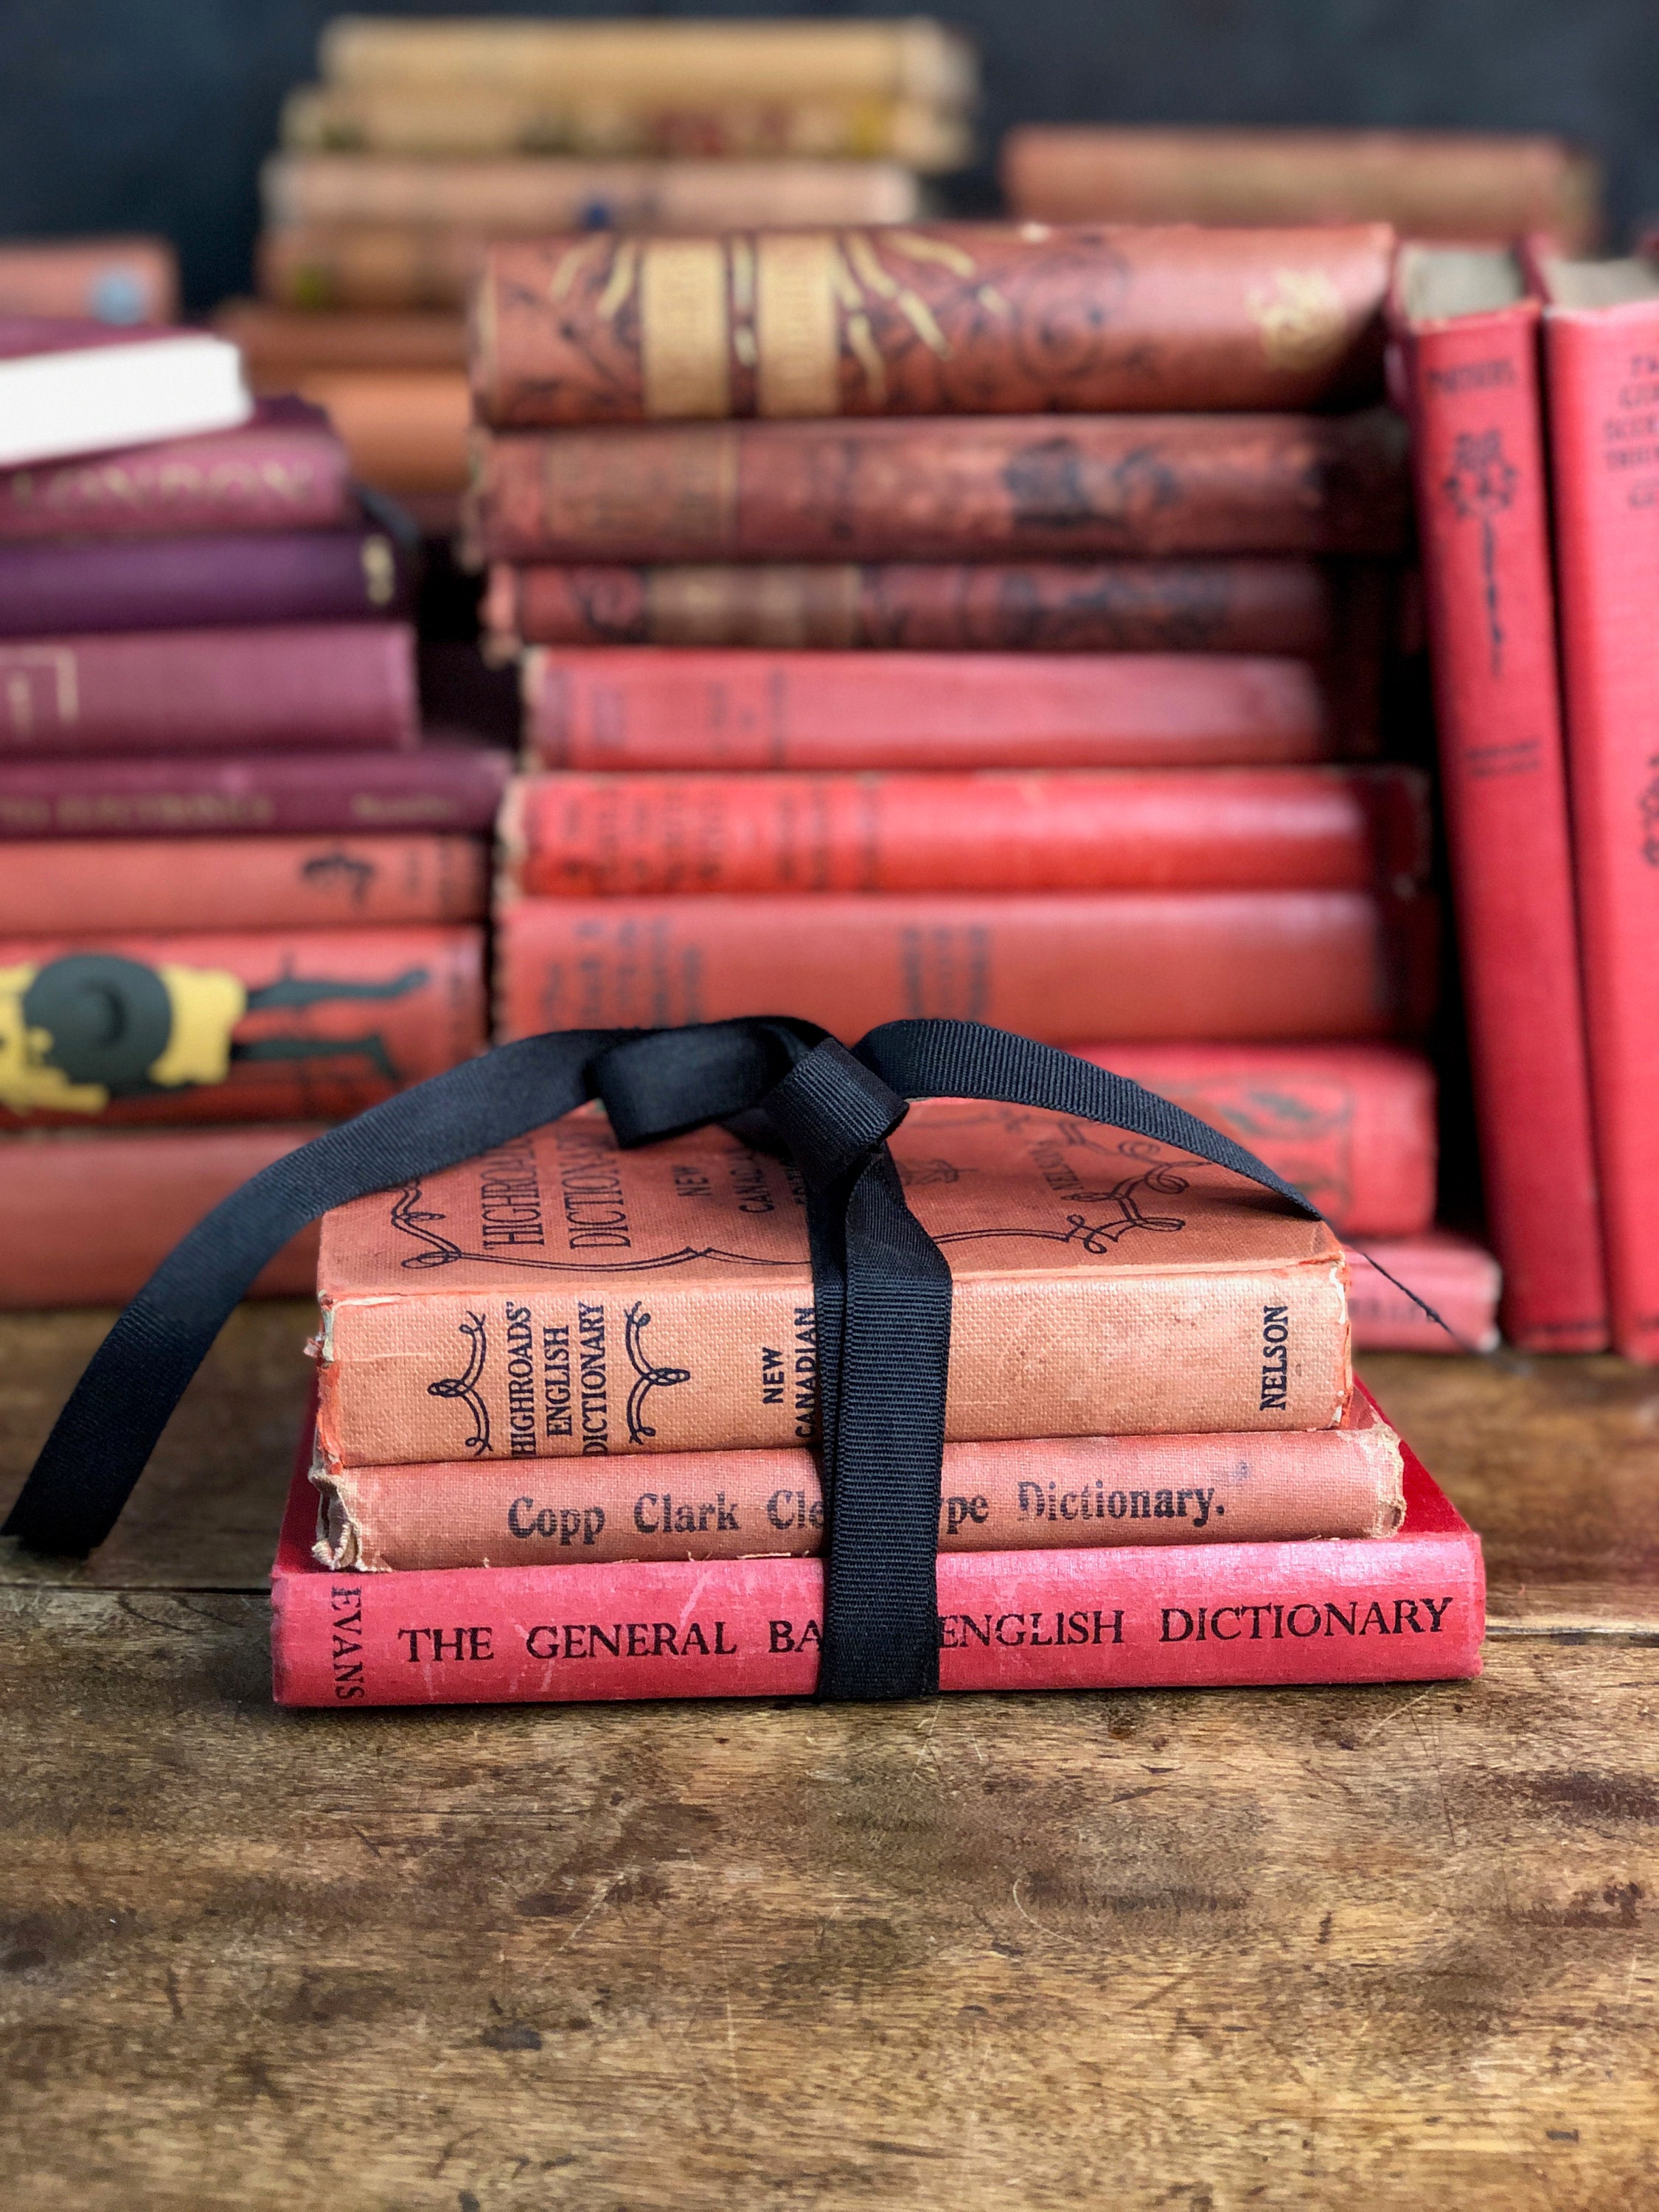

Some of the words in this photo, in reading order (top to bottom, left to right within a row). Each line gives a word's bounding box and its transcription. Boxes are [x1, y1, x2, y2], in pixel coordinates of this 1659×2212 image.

[673, 1164, 712, 1197] NEW
[543, 1324, 573, 1438] ENGLISH
[577, 1301, 608, 1457] DICTIONARY
[762, 1346, 784, 1404] NEW
[794, 1306, 817, 1439] CANADIAN
[1259, 1305, 1289, 1412] NELSON
[507, 1495, 605, 1545] Copp
[633, 1491, 742, 1534] Clark
[767, 1489, 824, 1530] Cle
[1018, 1480, 1225, 1528] Dictionary.
[330, 1585, 364, 1700] EVANS
[398, 1625, 495, 1663] THE
[526, 1621, 737, 1660] GENERAL
[937, 1609, 1124, 1649] ENGLISH
[1159, 1596, 1453, 1644] DICTIONARY
